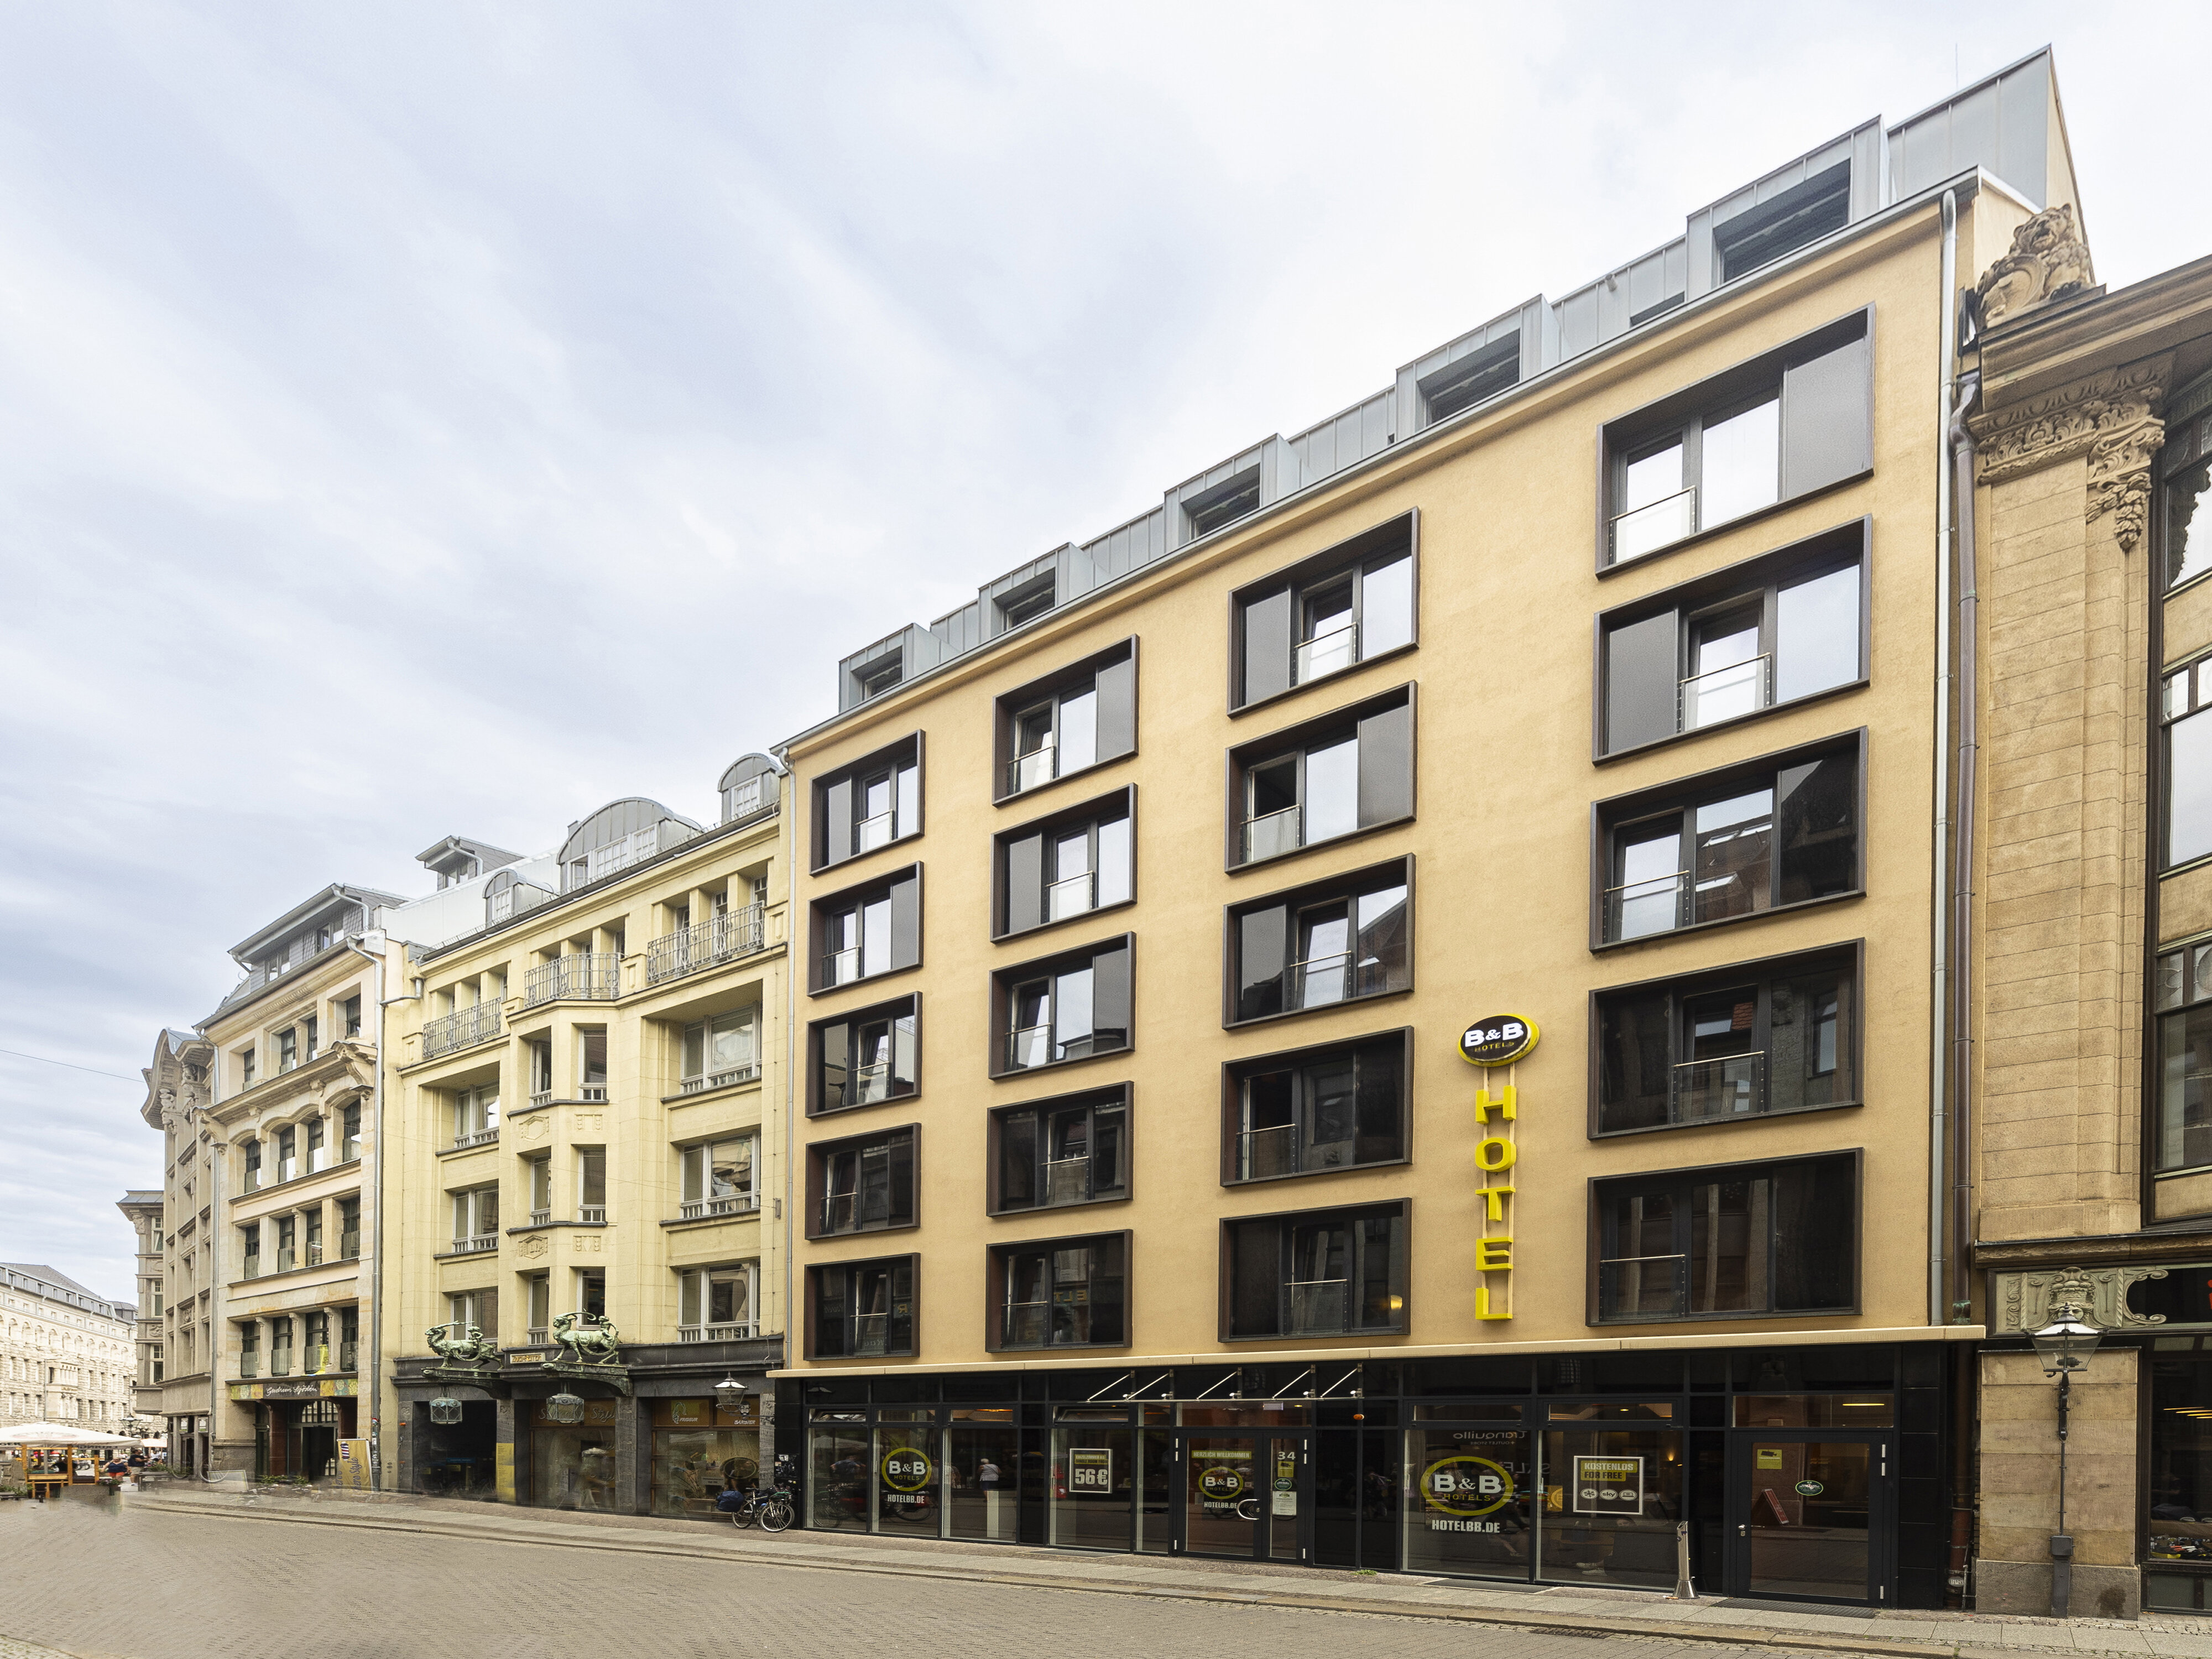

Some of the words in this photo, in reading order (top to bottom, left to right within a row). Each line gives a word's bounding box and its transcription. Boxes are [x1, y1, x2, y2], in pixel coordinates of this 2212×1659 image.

[1465, 1022, 1524, 1047] B&B
[1474, 1041, 1515, 1052] HOTELS
[1475, 1084, 1517, 1321] HOTEL
[1277, 1452, 1296, 1460] 34
[889, 1461, 926, 1475] B&B
[1584, 1463, 1634, 1471] KOSTENLOS
[1075, 1469, 1095, 1485] 56
[1205, 1477, 1238, 1487] B&B
[1434, 1474, 1502, 1494] B&B
[887, 1494, 925, 1504] HOTELBB.DE
[1432, 1520, 1500, 1533] HOTELBB.DE
